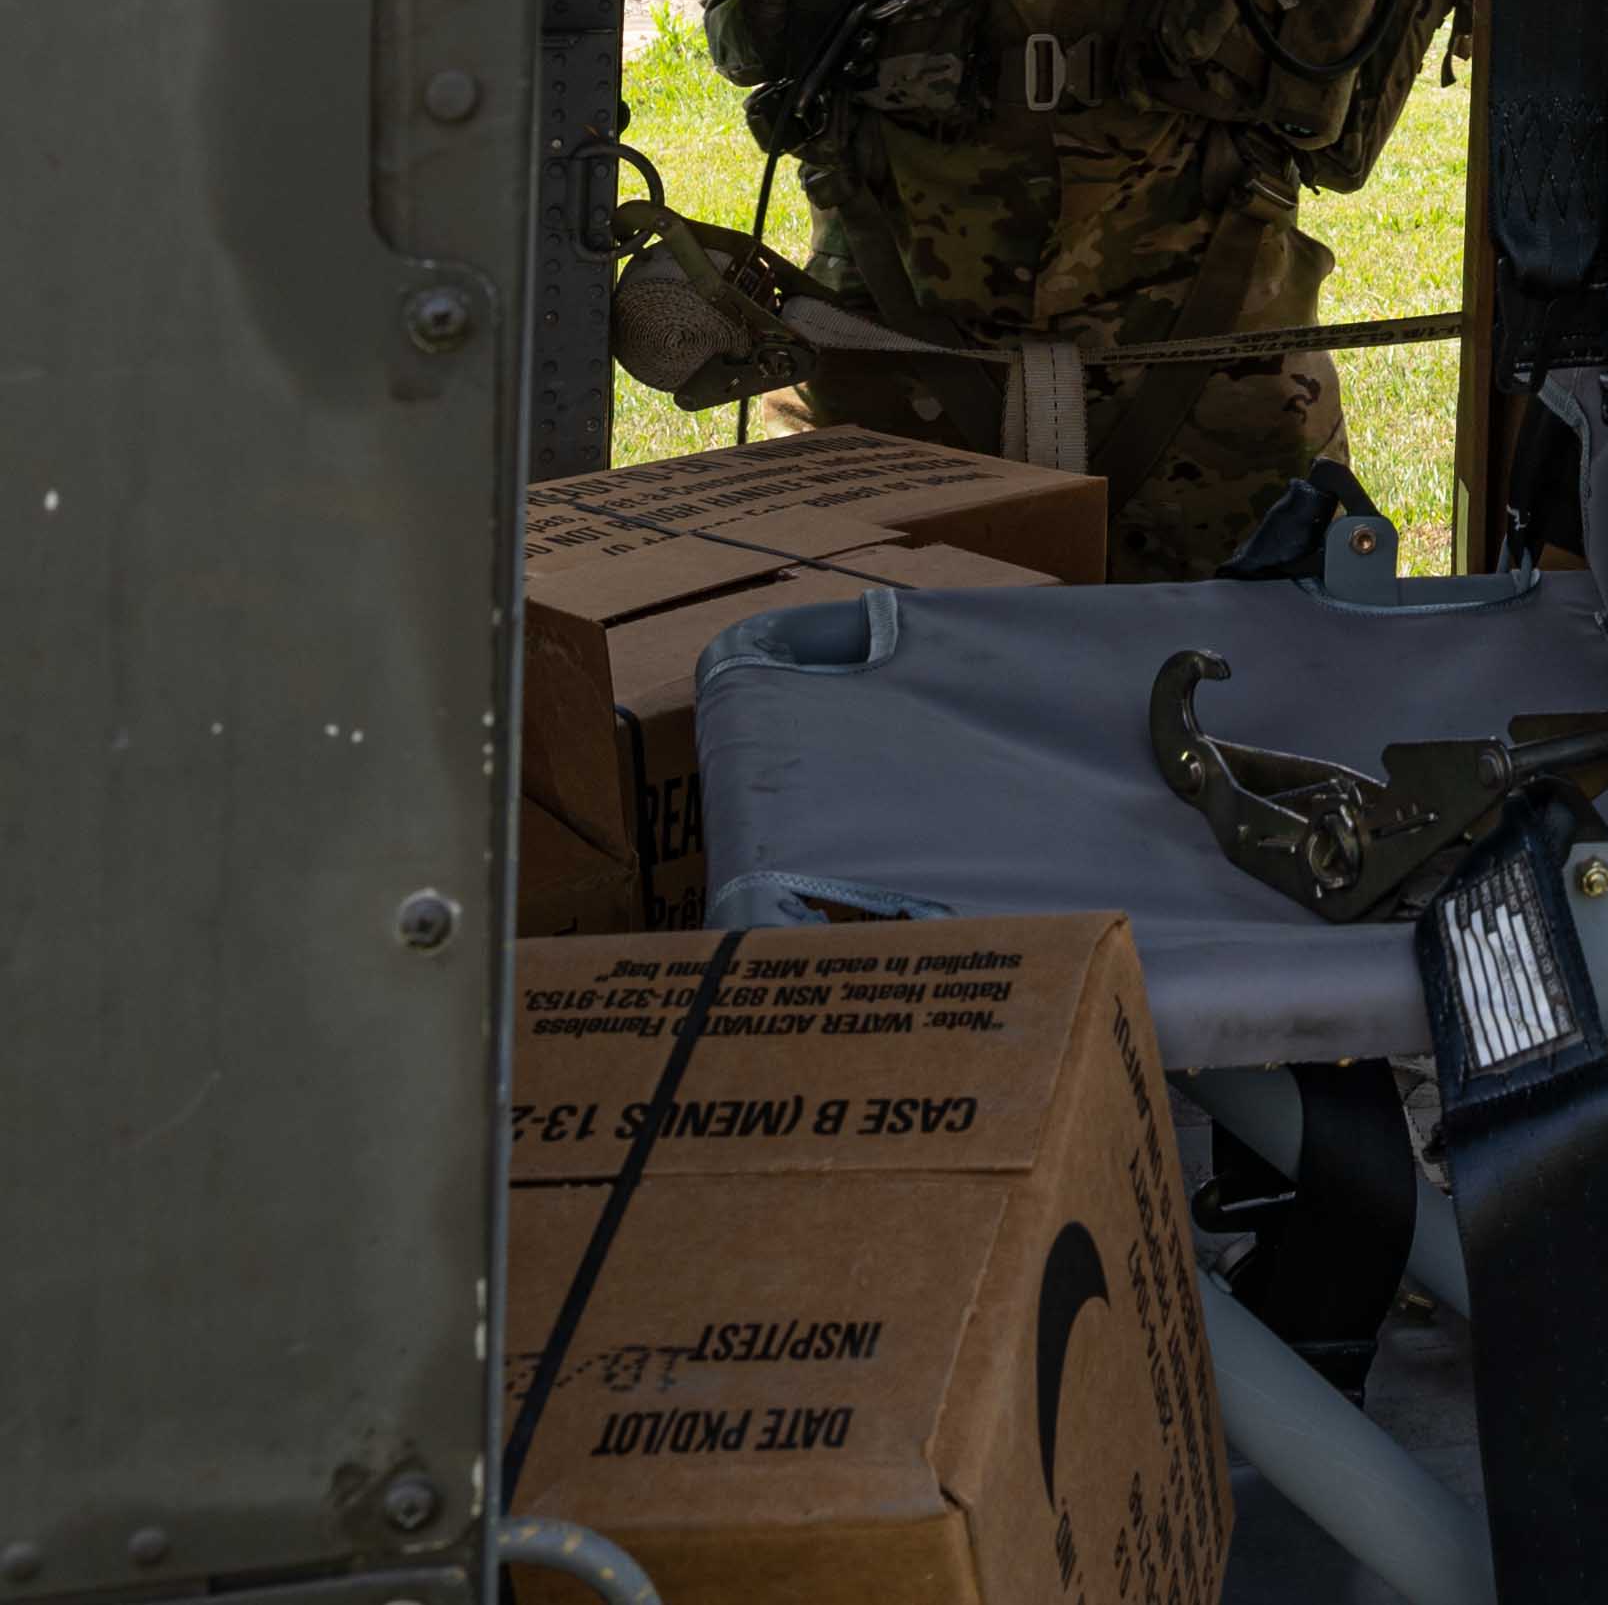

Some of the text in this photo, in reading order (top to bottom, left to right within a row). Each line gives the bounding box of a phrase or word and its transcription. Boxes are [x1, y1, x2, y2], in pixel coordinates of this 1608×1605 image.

[545, 524, 612, 547] NOT
[700, 476, 816, 508] HANDLE
[643, 771, 703, 867] REA
[741, 957, 810, 980] MRE
[814, 955, 879, 978] each
[884, 955, 910, 977] in
[914, 950, 1023, 976] supplied
[771, 985, 832, 1007] NSN
[840, 982, 927, 1004] Heater,
[931, 981, 1013, 1003] Ration
[532, 1015, 667, 1040] Flameless
[671, 1013, 817, 1037] ACTIVATD
[820, 1011, 913, 1036] WATER
[510, 1103, 599, 1143] 13-2
[811, 1098, 850, 1136] B
[856, 1097, 978, 1135] CASE
[684, 1319, 883, 1363] INSP/TEST
[590, 1407, 854, 1458] DATE PKD/LOT
